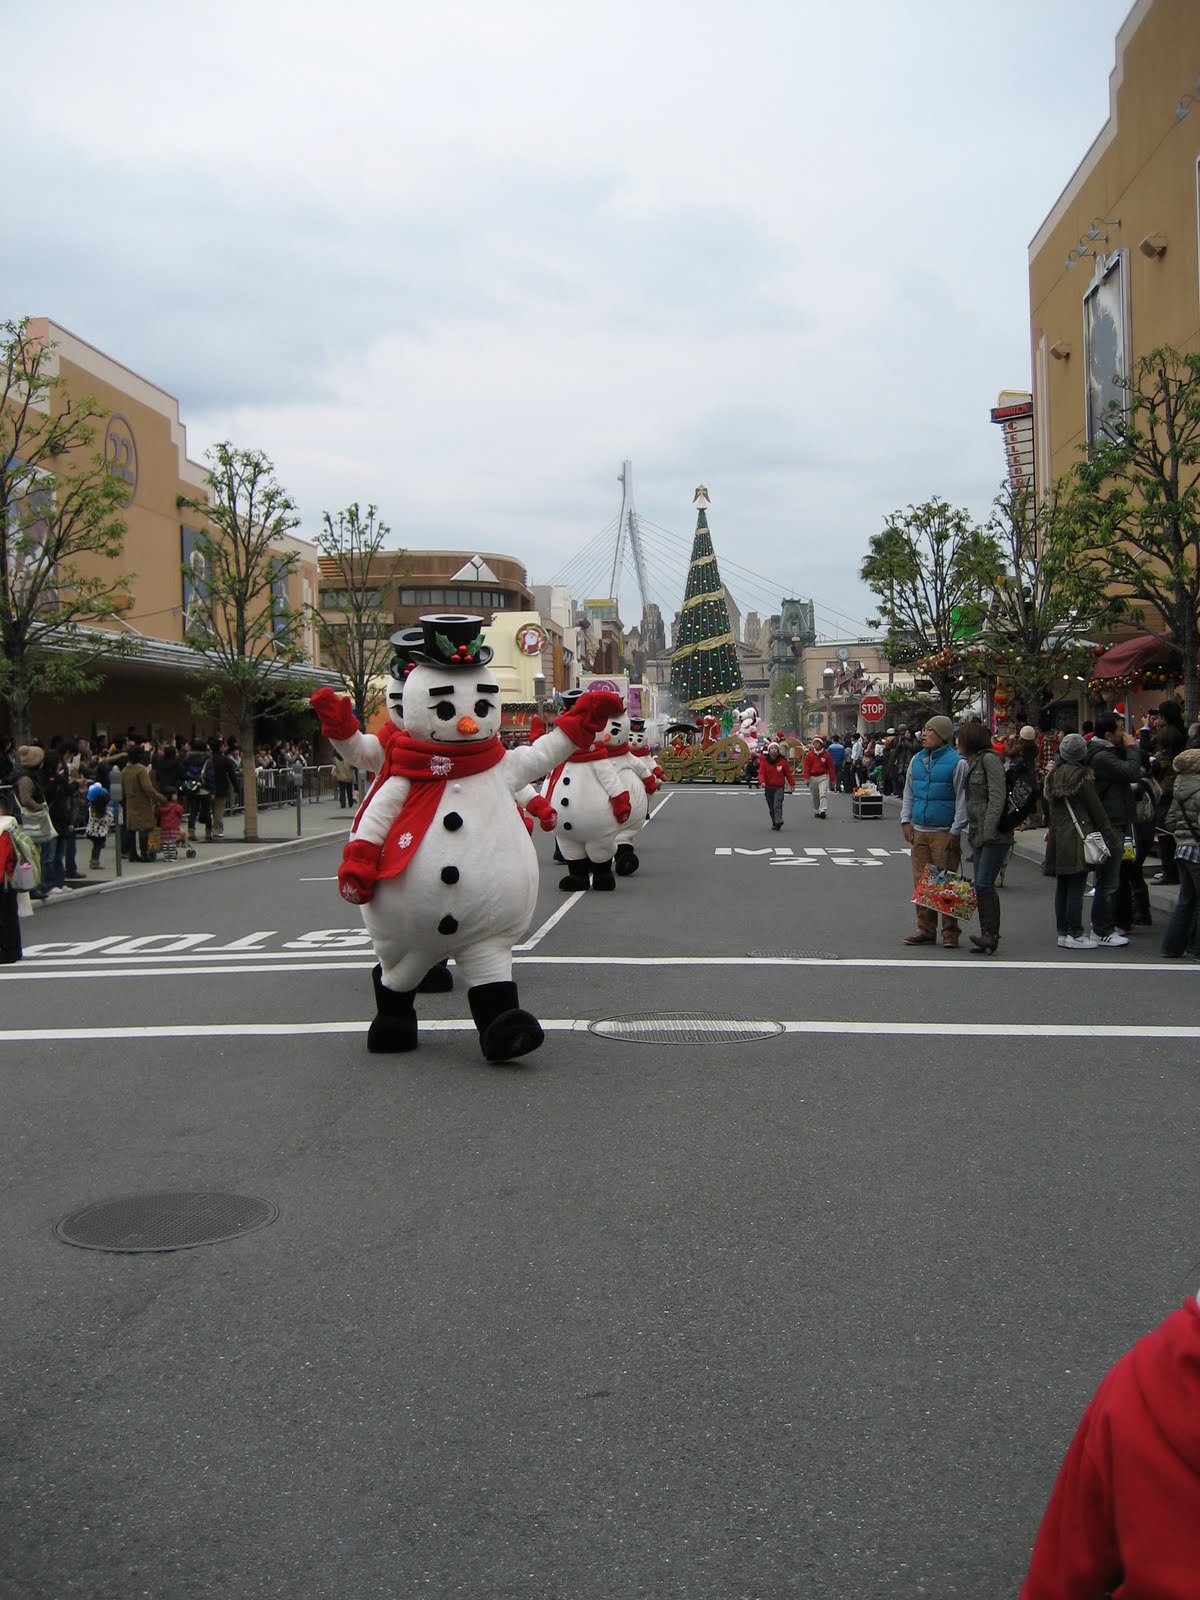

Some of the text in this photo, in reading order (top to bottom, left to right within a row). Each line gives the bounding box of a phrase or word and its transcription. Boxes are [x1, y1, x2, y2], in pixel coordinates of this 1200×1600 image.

[110, 432, 134, 486] 22
[861, 703, 884, 714] STOP
[714, 847, 911, 856] MPH
[769, 857, 884, 866] 25
[22, 928, 373, 957] STOP
